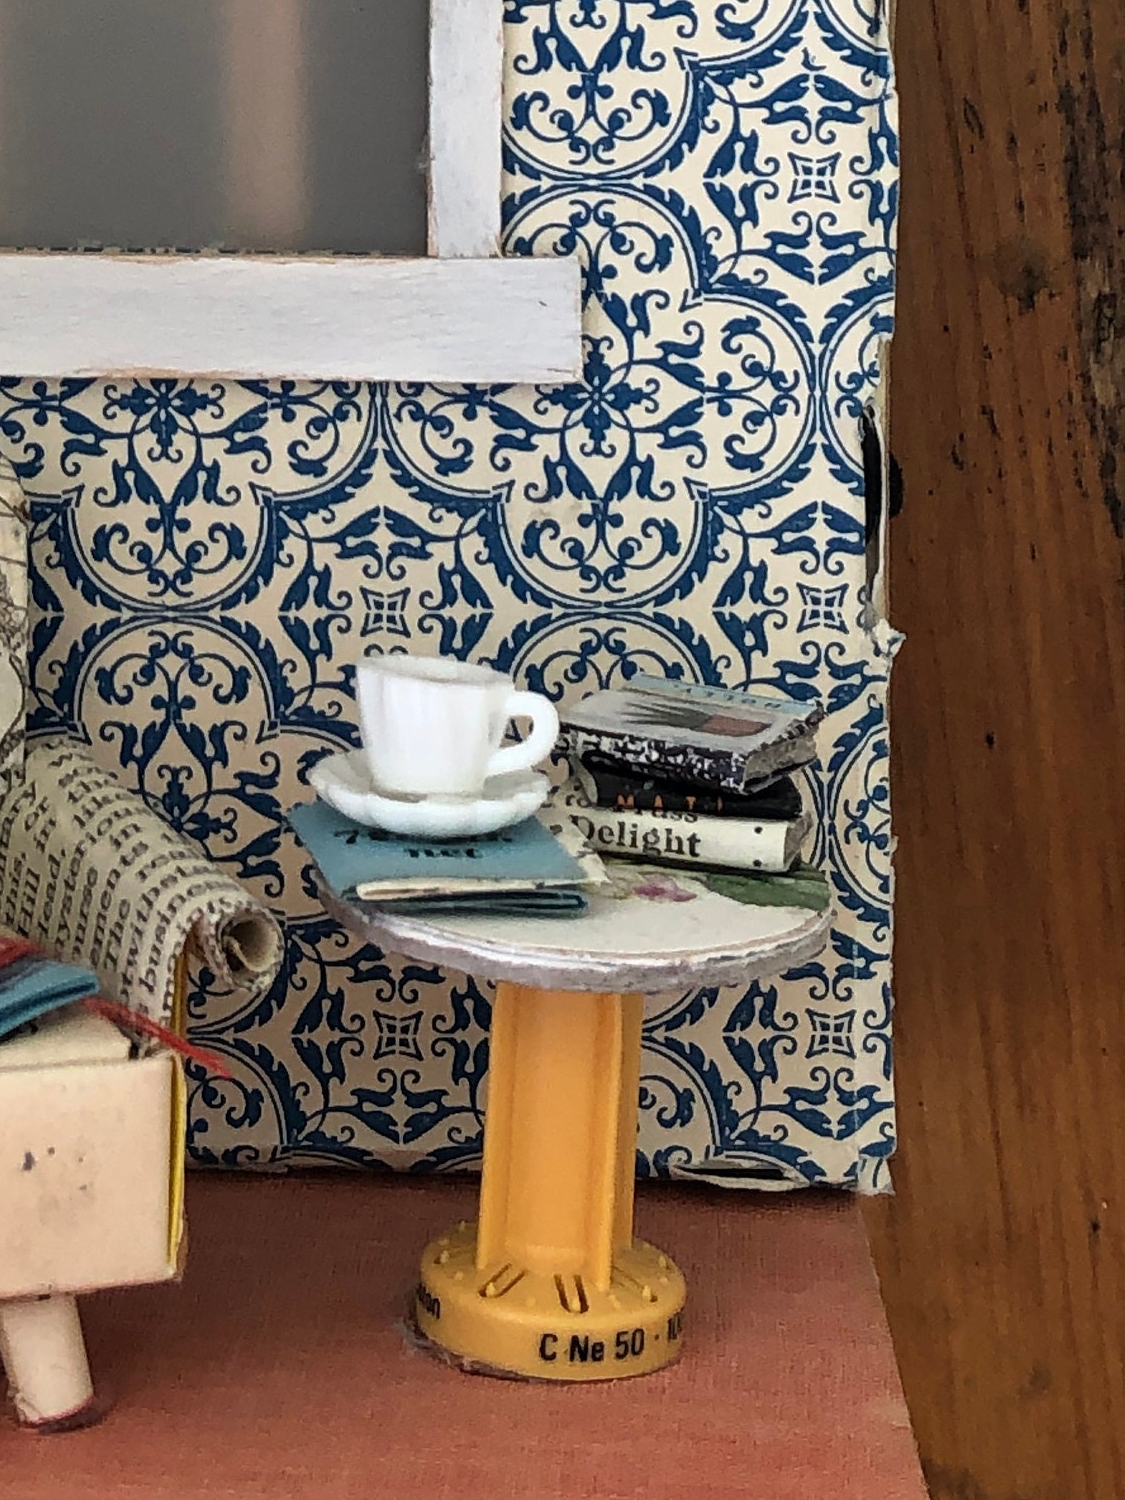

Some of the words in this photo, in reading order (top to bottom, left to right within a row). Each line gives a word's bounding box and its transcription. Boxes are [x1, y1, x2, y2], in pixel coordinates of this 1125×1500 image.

[537, 1332, 558, 1362] C
[568, 1333, 604, 1363] Ne
[614, 1327, 645, 1360] 50
